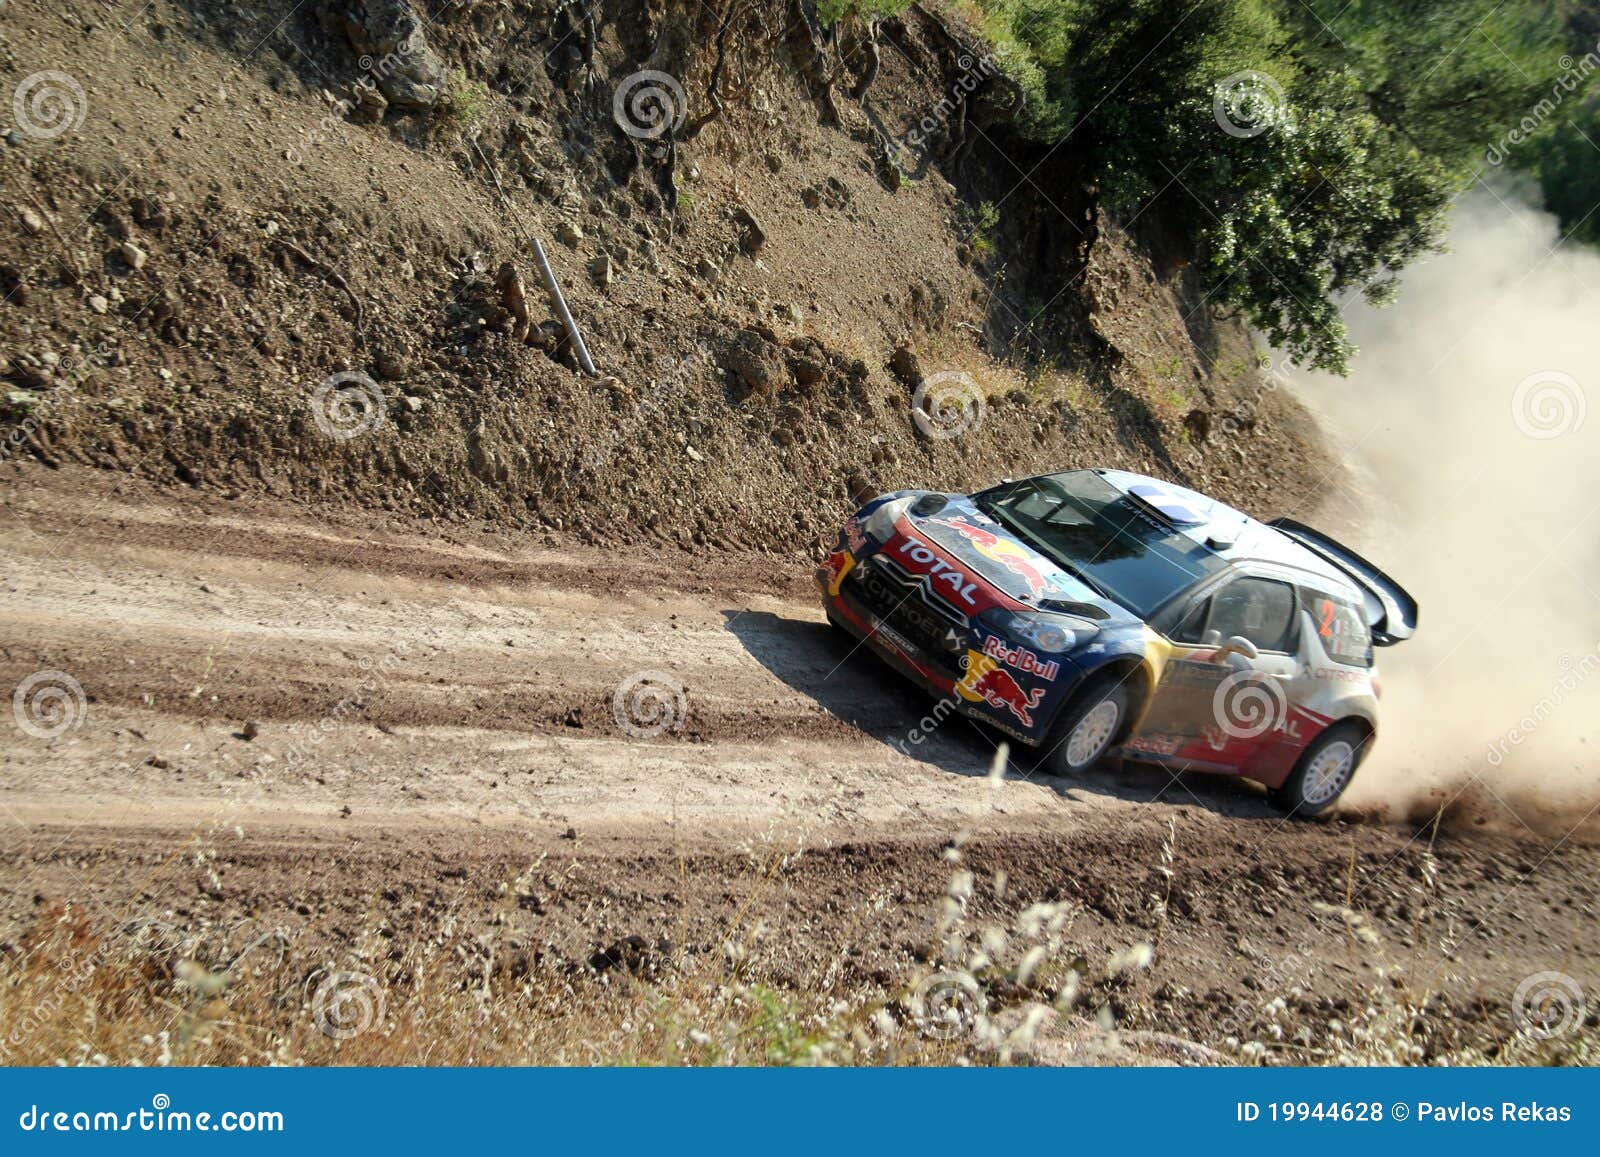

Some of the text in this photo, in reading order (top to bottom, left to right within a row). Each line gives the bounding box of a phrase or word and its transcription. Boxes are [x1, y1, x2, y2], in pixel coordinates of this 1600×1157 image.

[899, 535, 977, 606] TOTAL
[1320, 599, 1335, 638] 2
[1020, 650, 1060, 682] Bull
